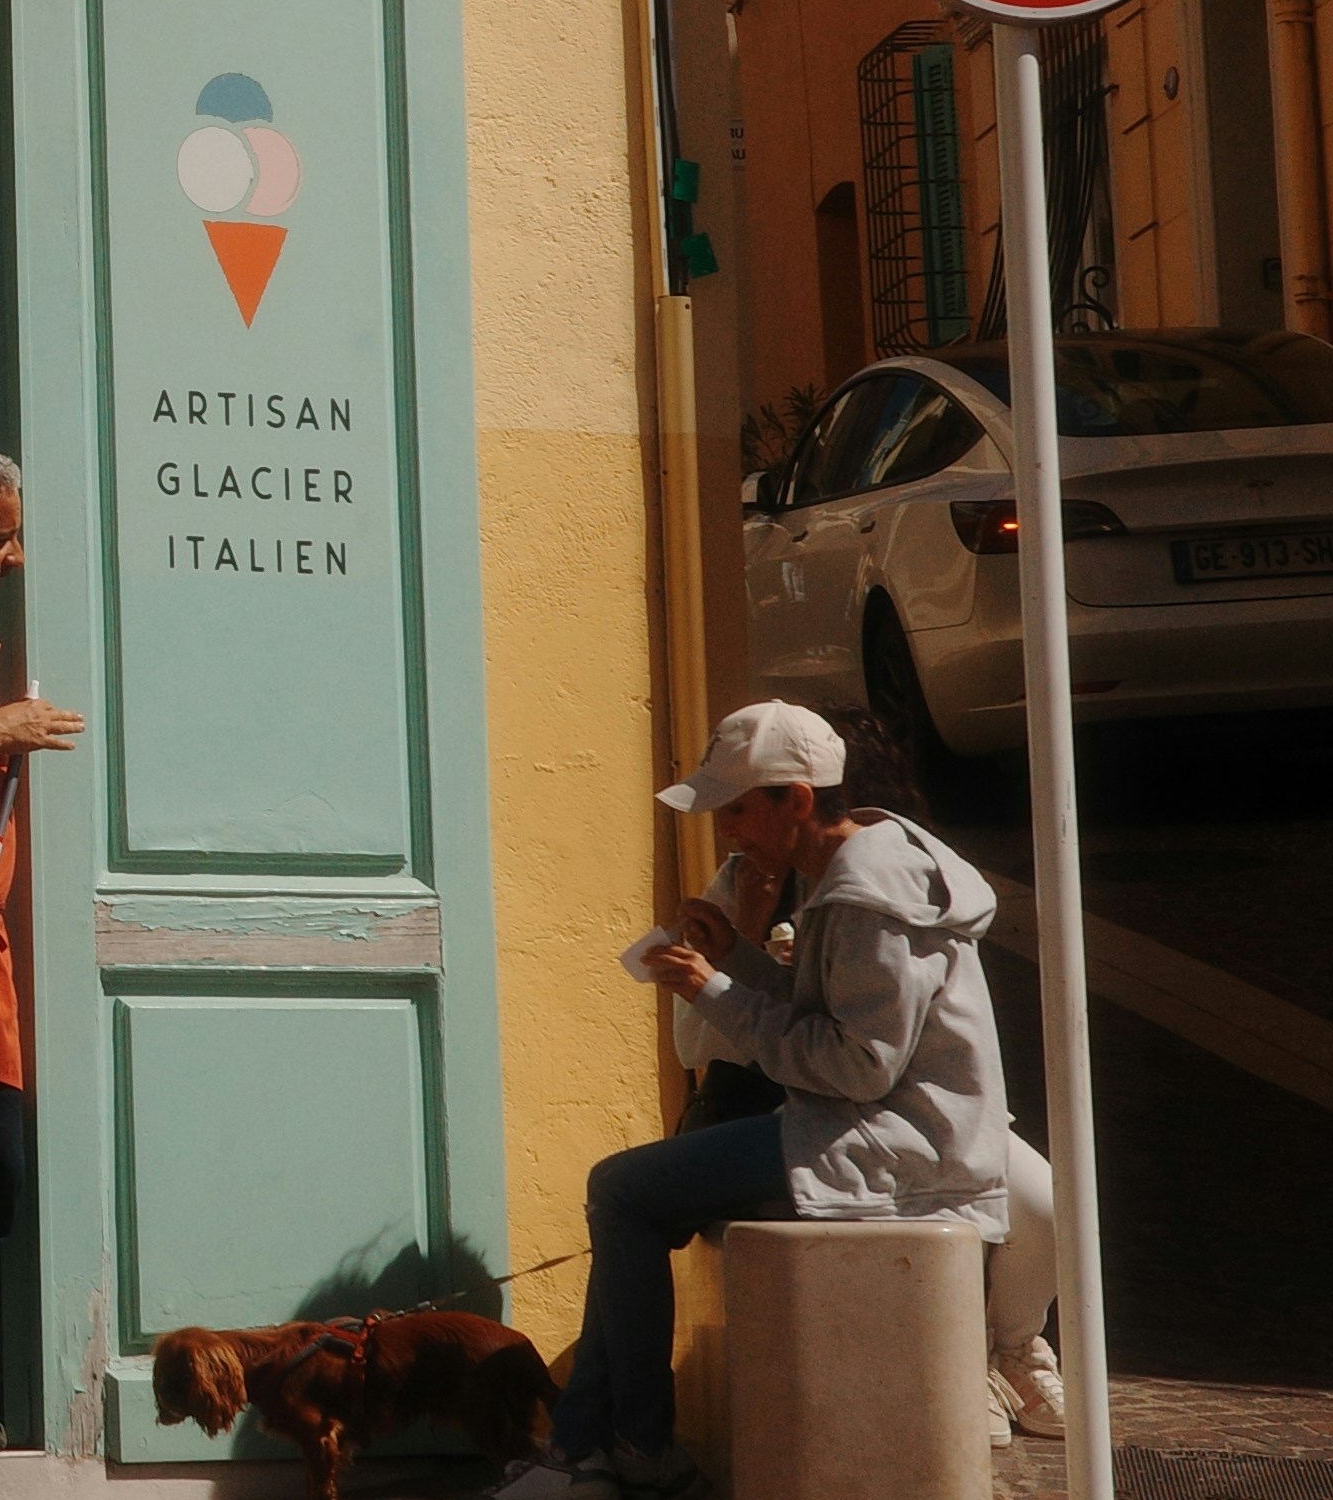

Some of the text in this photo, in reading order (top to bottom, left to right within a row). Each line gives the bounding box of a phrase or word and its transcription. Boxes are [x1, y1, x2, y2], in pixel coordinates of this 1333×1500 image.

[152, 389, 353, 432] ARTISAN
[156, 462, 355, 504] GLACIER
[168, 535, 348, 577] ITALIEN
